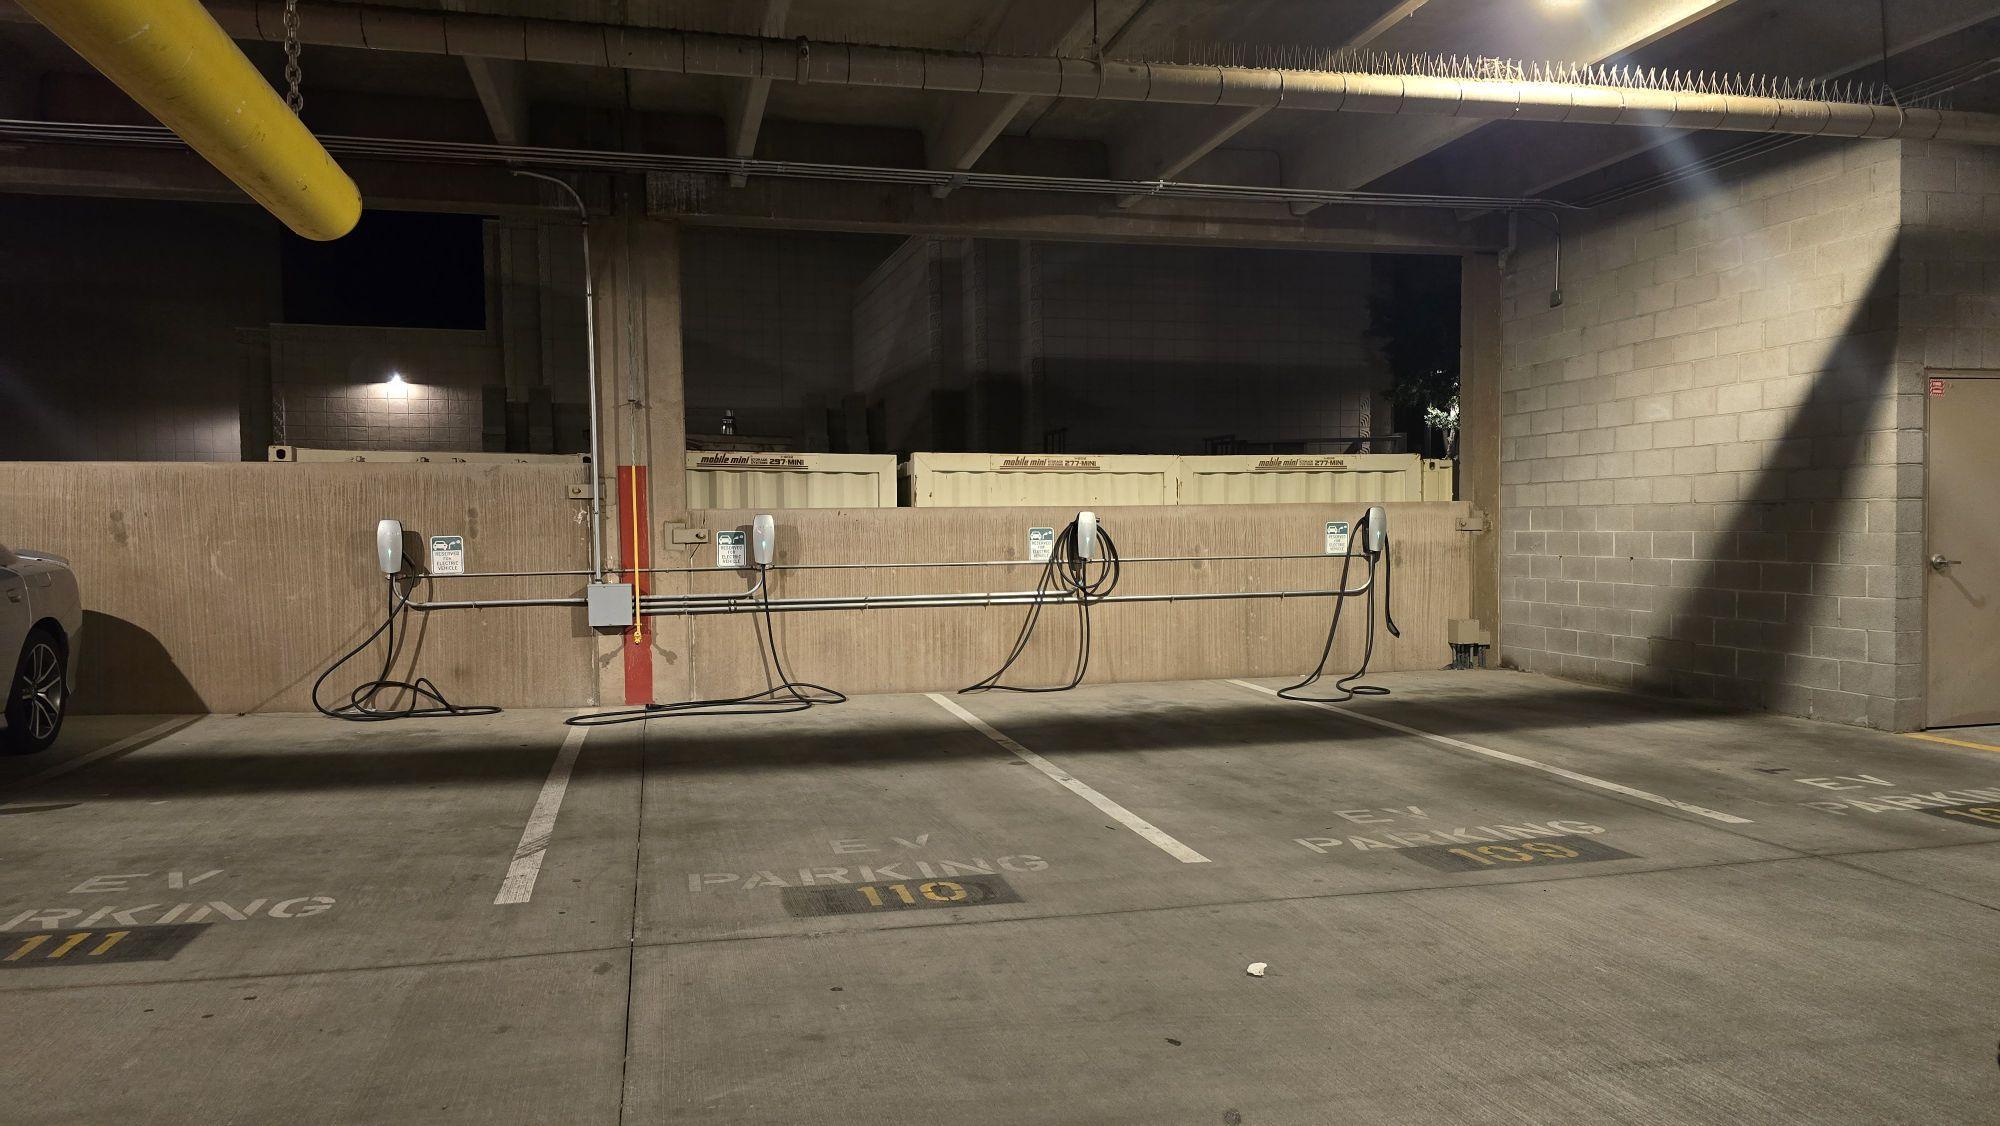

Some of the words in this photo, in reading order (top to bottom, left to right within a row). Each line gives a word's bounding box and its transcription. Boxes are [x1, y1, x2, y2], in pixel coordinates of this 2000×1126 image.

[701, 453, 729, 464] mobile
[731, 456, 750, 464] mini
[1003, 456, 1029, 466] mobile
[1029, 458, 1047, 466] mini
[1258, 457, 1283, 467] mobile
[1283, 458, 1299, 466] mini
[1793, 774, 1896, 791] EV
[1332, 805, 1431, 825] EV
[828, 833, 929, 855] EV
[1293, 820, 1606, 854] PARKING
[67, 869, 225, 894] EV
[687, 854, 1050, 892] PARKING
[857, 881, 968, 907] 110
[3, 930, 131, 962] 111
